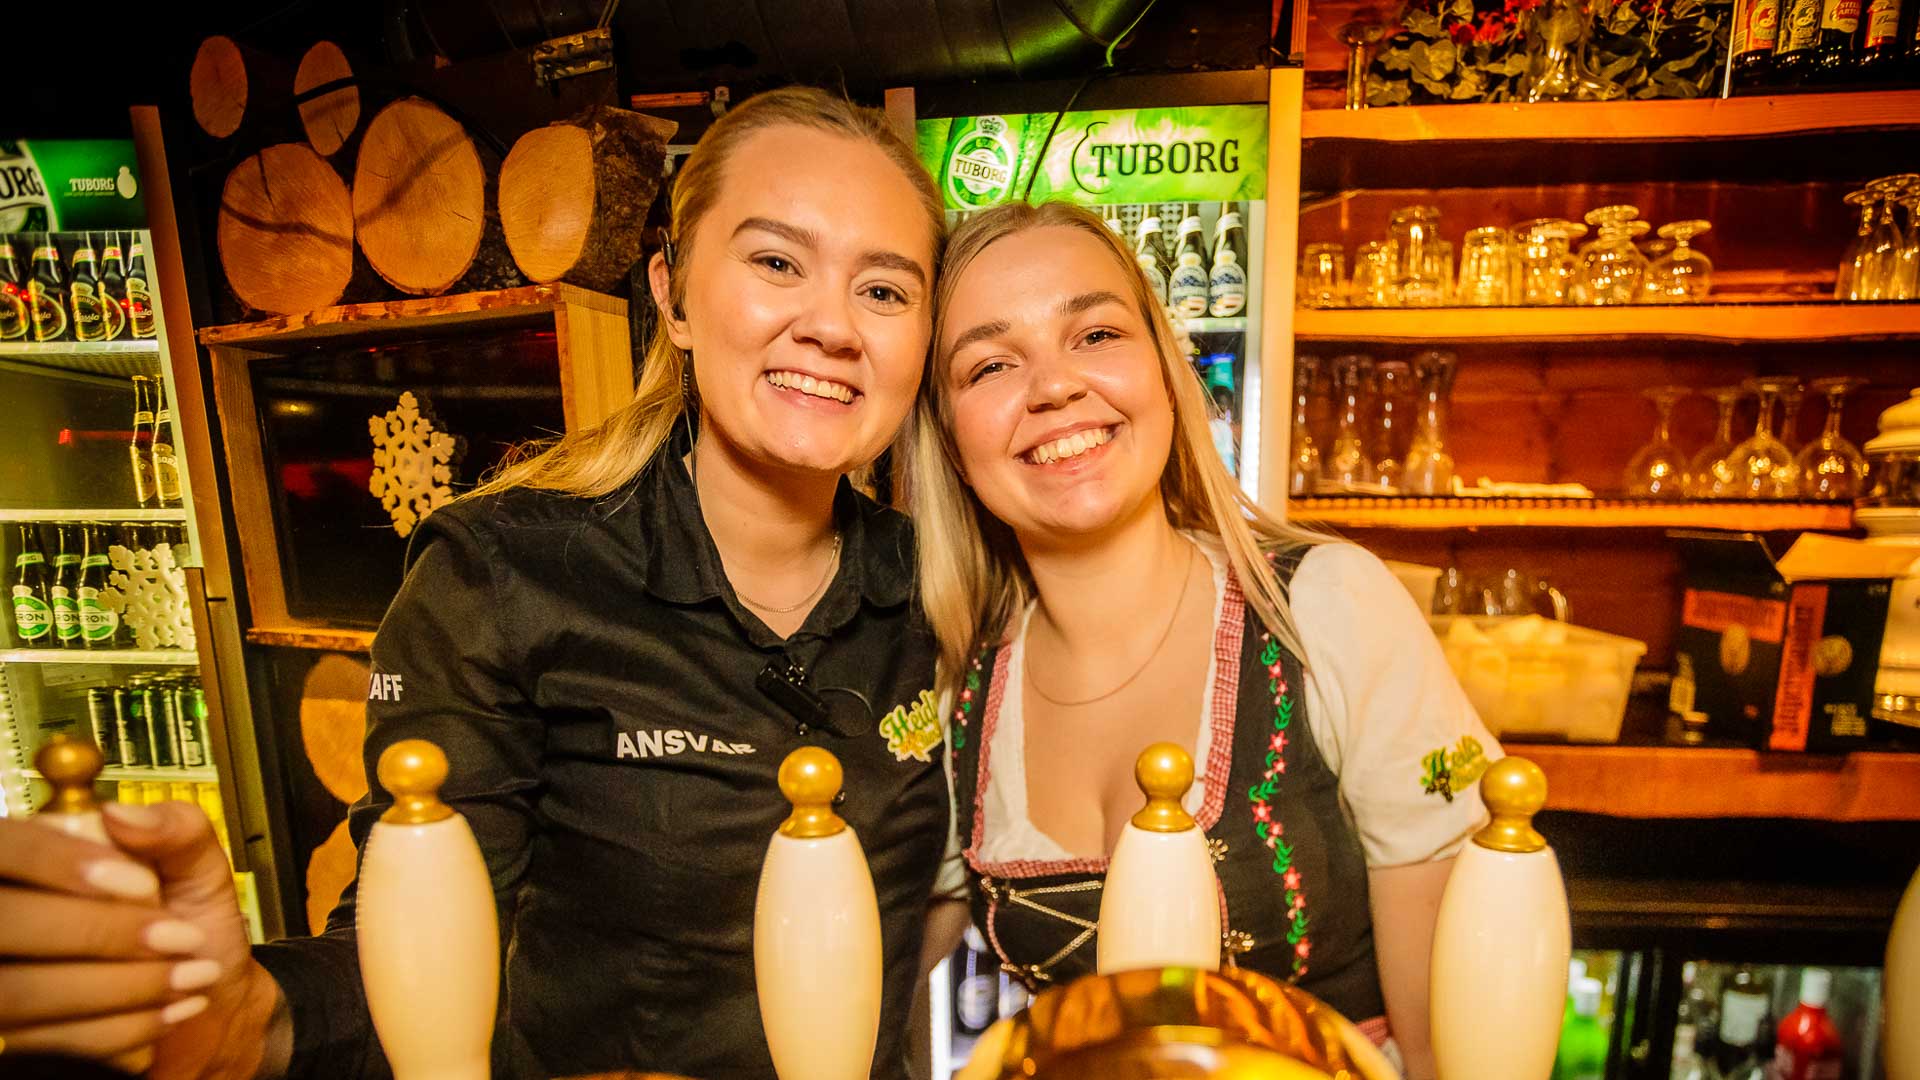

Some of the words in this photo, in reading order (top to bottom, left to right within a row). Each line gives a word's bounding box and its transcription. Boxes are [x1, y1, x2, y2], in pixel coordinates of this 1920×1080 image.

[955, 158, 1008, 184] TUBORG
[1091, 138, 1240, 178] TUBORG
[0, 166, 45, 199] ORG
[69, 177, 115, 192] TUBORG
[369, 672, 404, 702] AFF
[616, 729, 757, 759] ANSVAR
